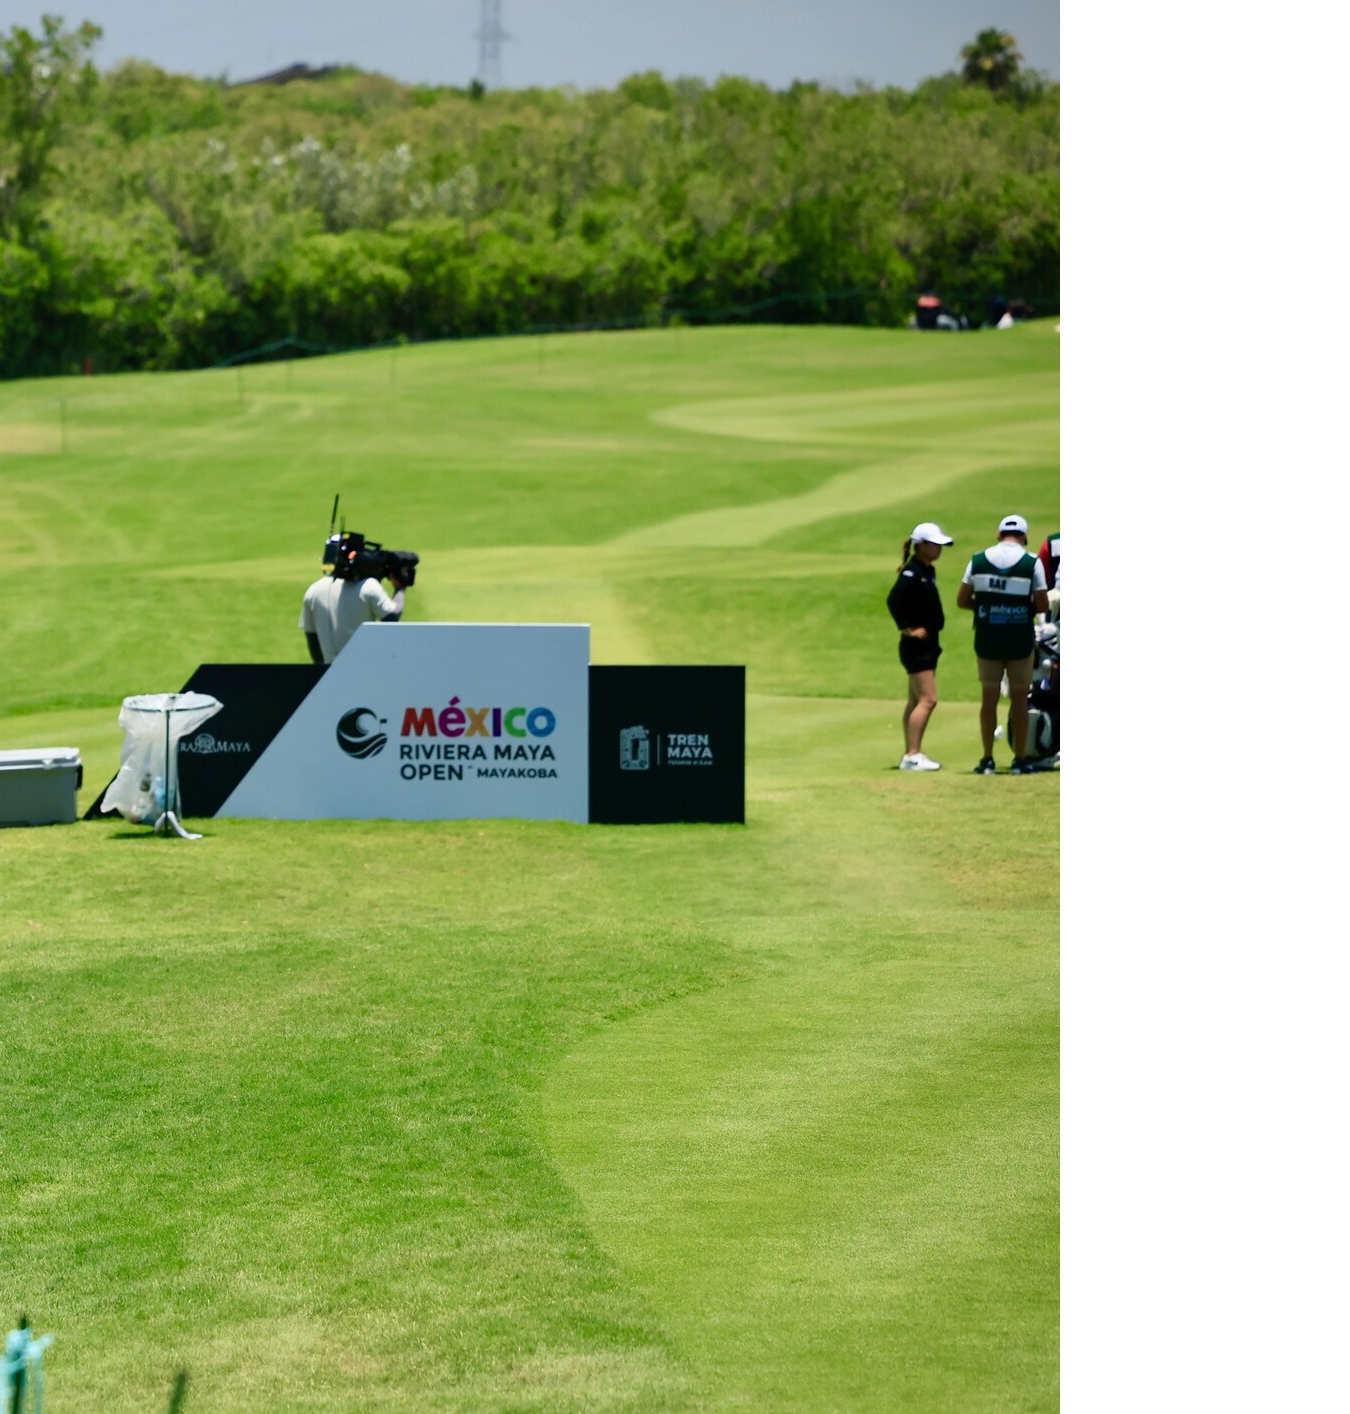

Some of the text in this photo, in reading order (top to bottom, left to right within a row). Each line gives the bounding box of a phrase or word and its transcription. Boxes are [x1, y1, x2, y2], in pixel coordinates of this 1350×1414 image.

[216, 740, 251, 752] MAYA
[667, 734, 709, 746] TREN
[400, 744, 555, 760] RIVIERA MAYA
[667, 746, 713, 758] MAYA
[400, 764, 558, 780] OPEN MAYAKOBA
